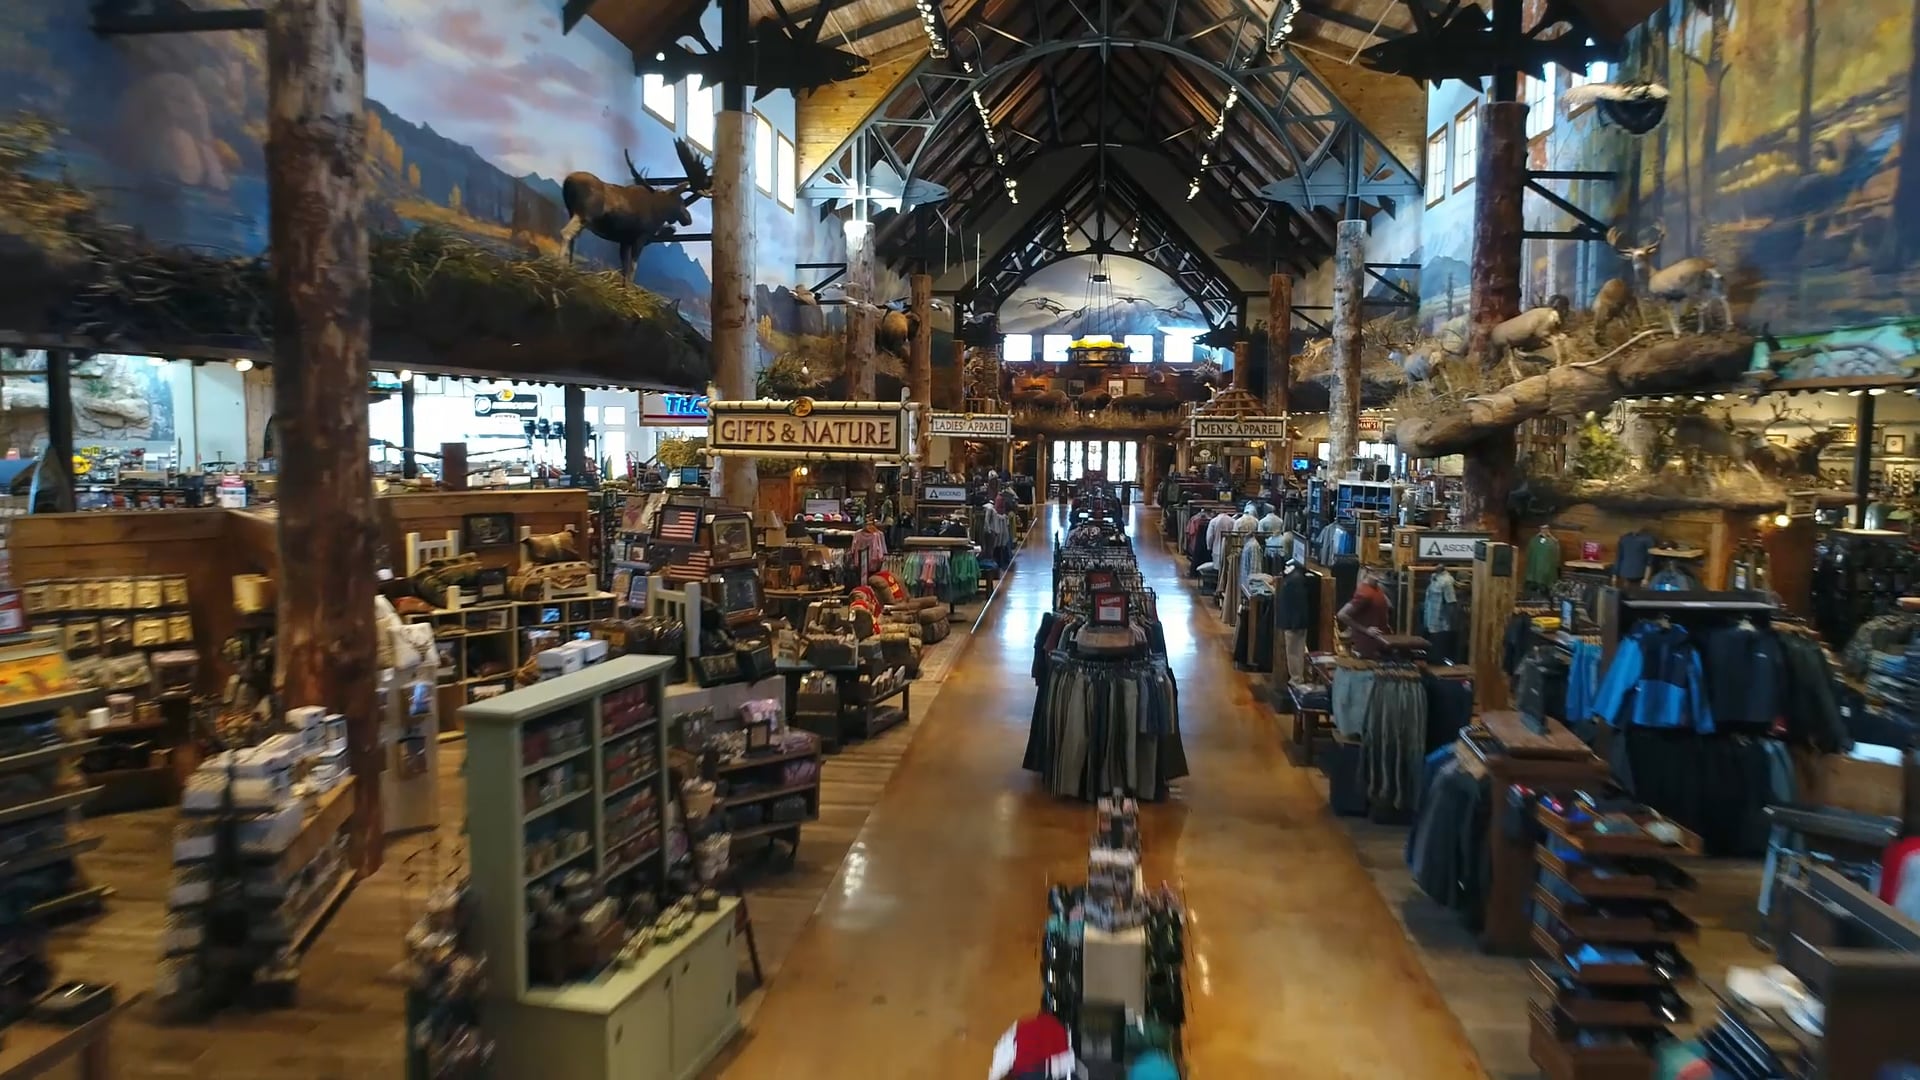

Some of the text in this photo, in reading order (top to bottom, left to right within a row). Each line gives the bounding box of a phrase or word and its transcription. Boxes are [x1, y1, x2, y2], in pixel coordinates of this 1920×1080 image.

[935, 421, 1004, 432] LADIES' APPAREL
[1201, 423, 1278, 434] MEN'S APPAREL
[721, 420, 891, 445] GIFTS & NATURE
[1443, 544, 1475, 553] ASCEN
